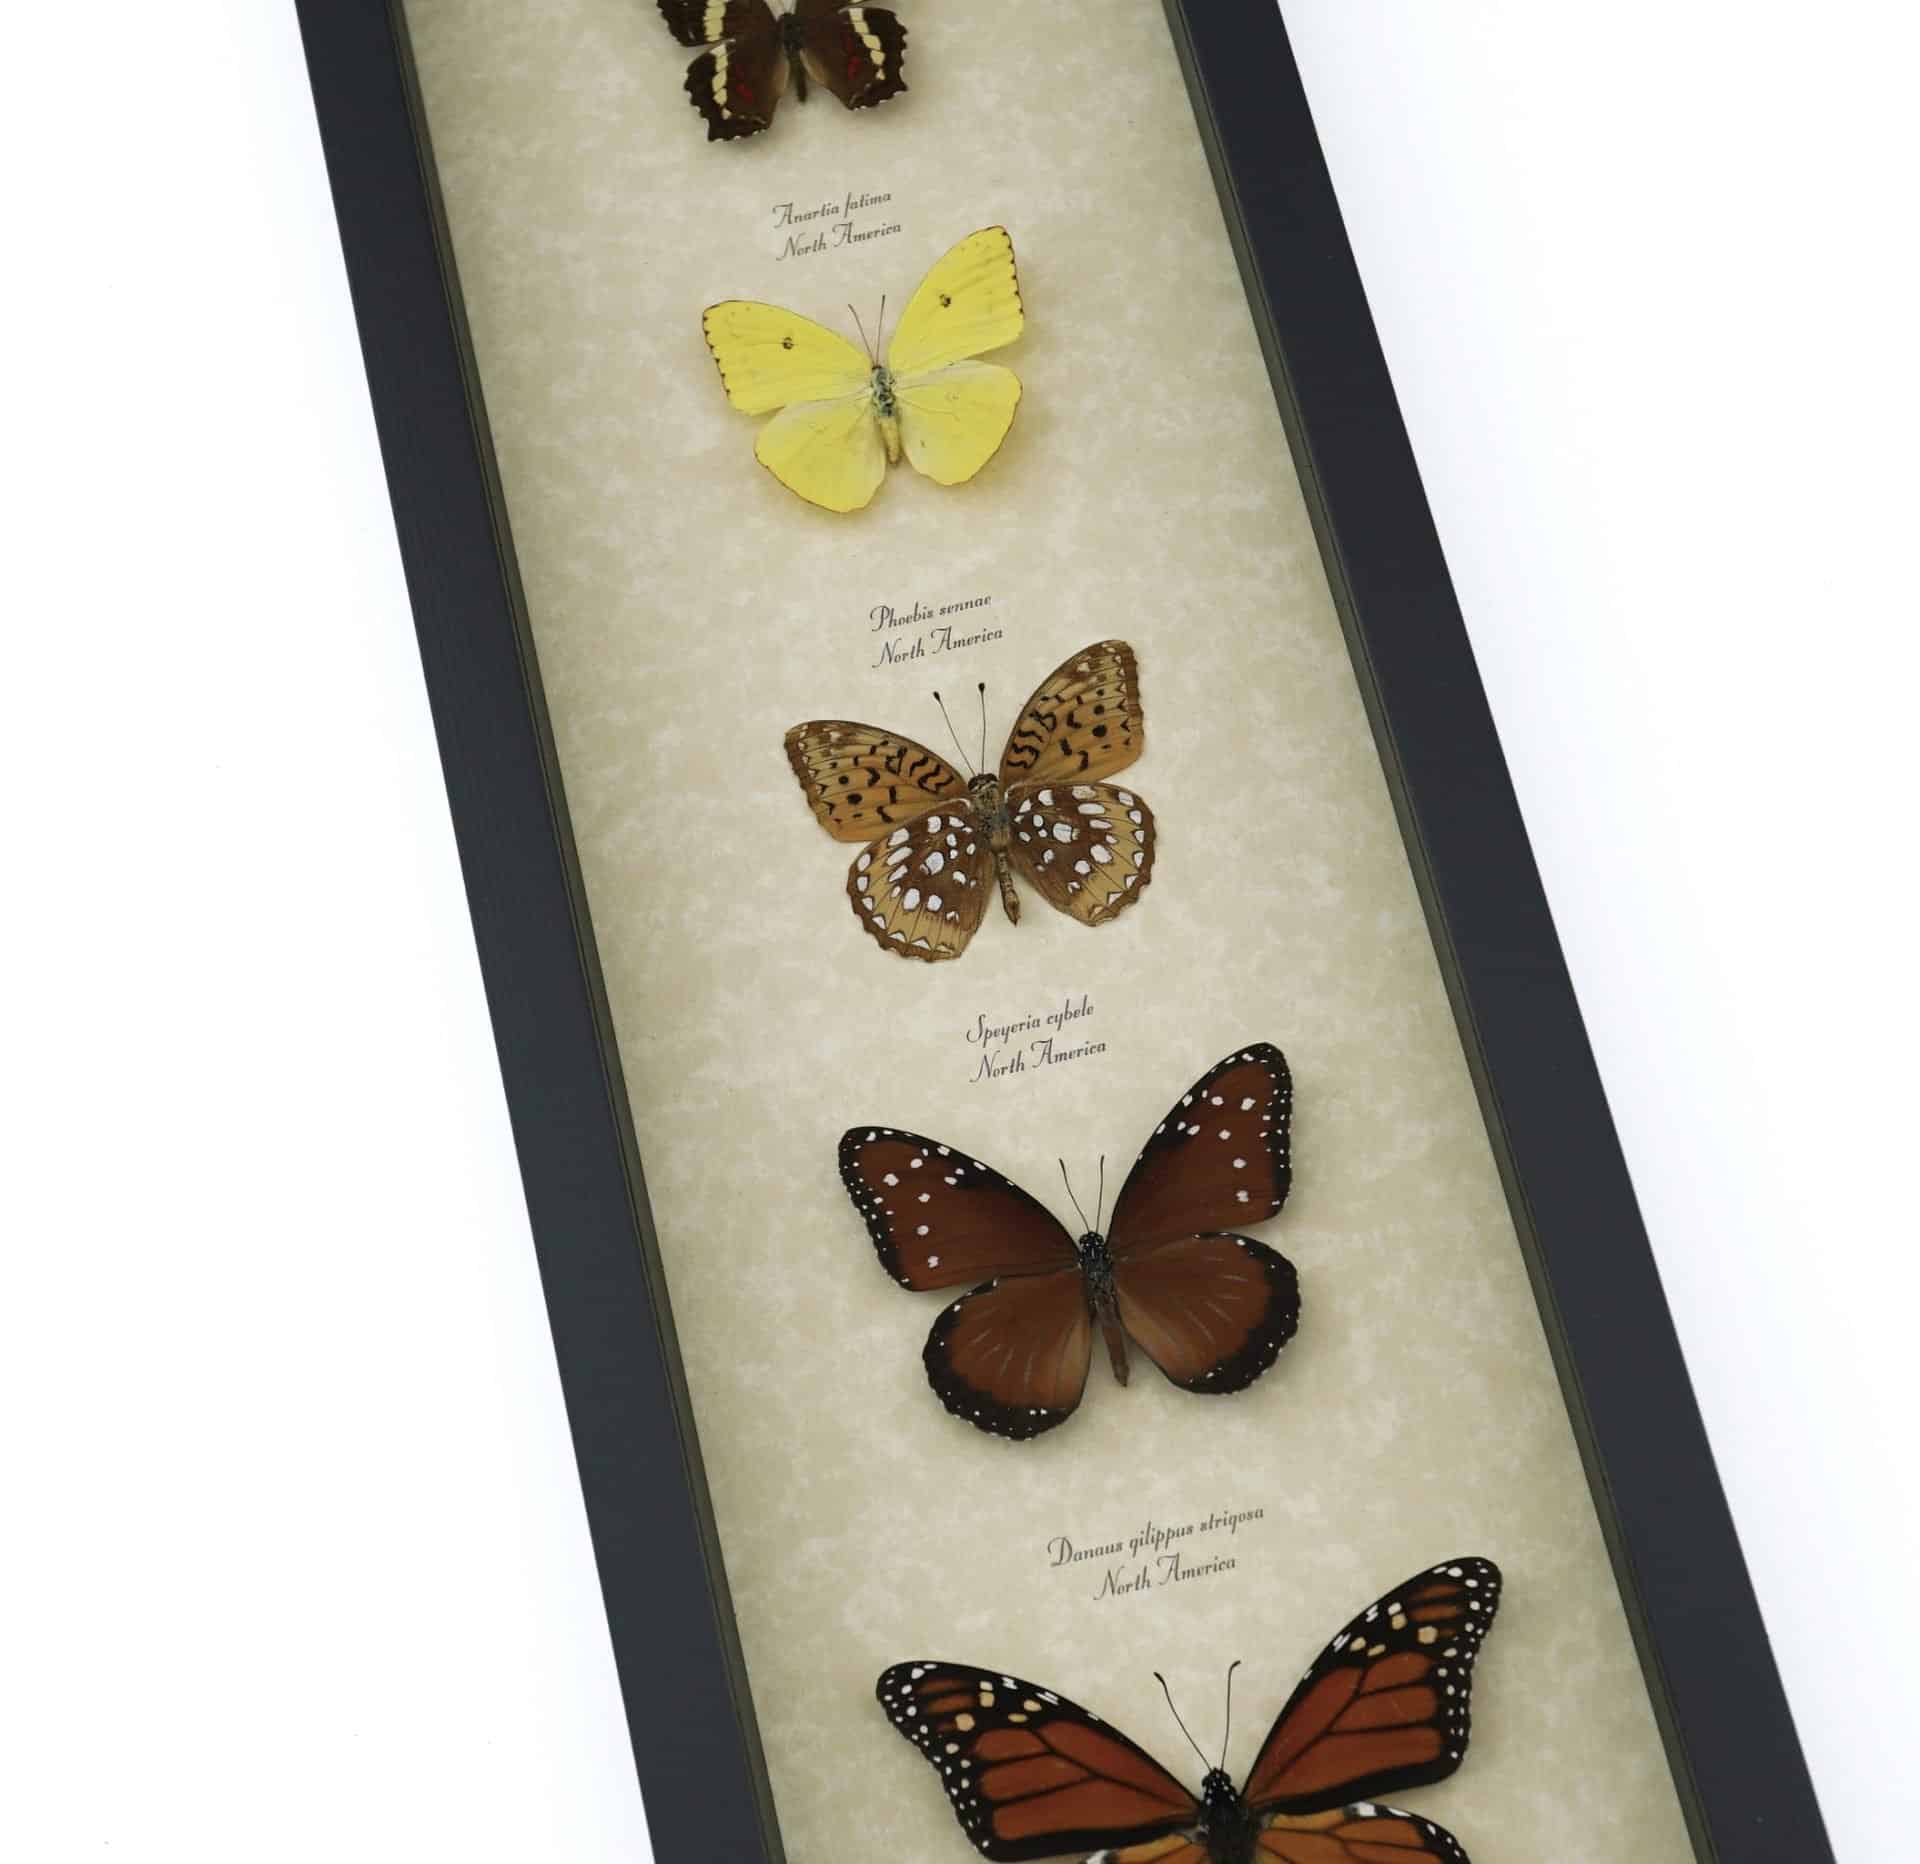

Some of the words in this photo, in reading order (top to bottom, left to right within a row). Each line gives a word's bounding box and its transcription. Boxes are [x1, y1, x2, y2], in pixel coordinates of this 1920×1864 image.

[772, 202, 840, 229] Anartia
[844, 191, 891, 219] fatima
[775, 232, 828, 261] North
[831, 221, 901, 248] America
[869, 601, 934, 632] Phoebis
[939, 595, 992, 616] sennae
[871, 637, 925, 668] North
[930, 625, 1003, 654] America
[966, 1013, 1041, 1048] Speyeria
[1046, 994, 1094, 1031] cybele
[969, 1049, 1025, 1083] North
[1030, 1036, 1107, 1069] America
[1047, 1535, 1124, 1567] Danaus
[1128, 1520, 1195, 1558] gilippus
[1199, 1507, 1265, 1535] strigosa
[1093, 1564, 1152, 1600] North
[1156, 1552, 1237, 1586] America
